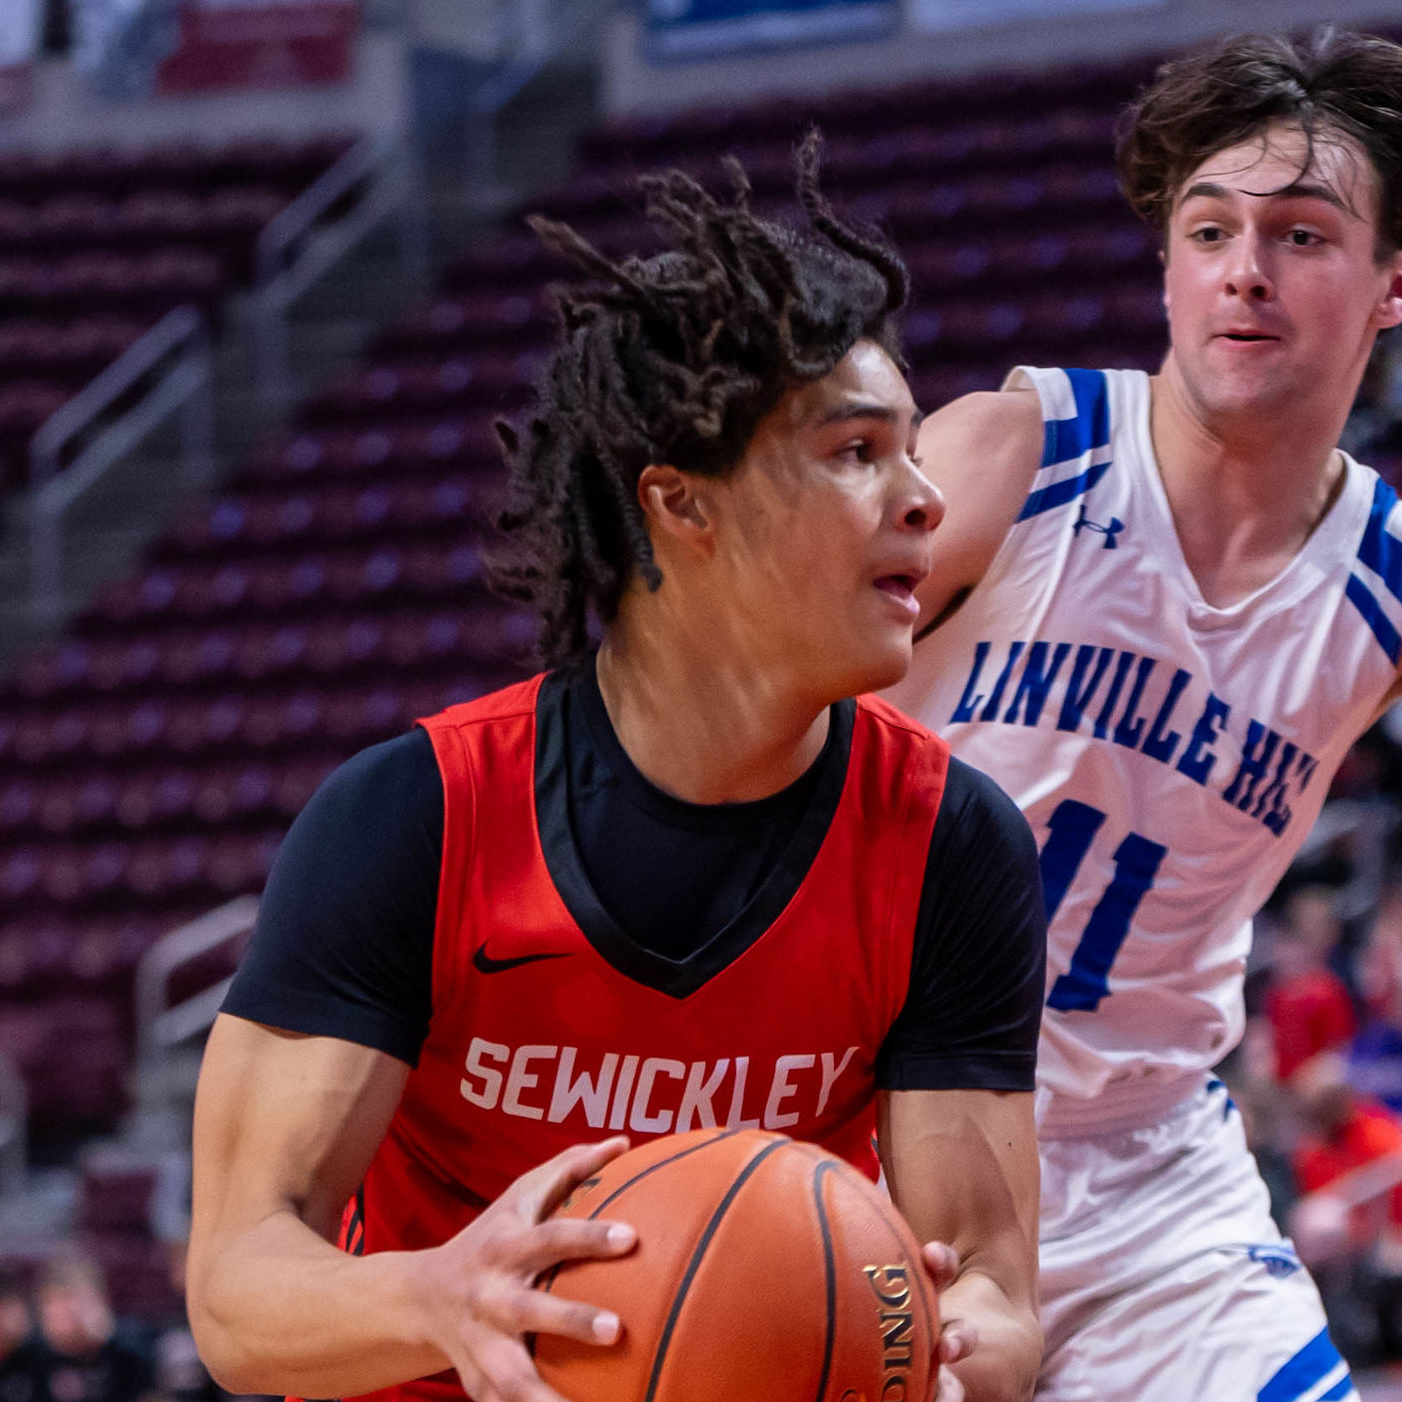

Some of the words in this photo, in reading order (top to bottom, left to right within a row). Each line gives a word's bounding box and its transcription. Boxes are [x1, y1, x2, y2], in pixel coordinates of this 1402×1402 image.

[949, 641, 1228, 786] LINVILLE
[1040, 799, 1168, 1012] 11
[459, 1036, 860, 1134] SEWICKLEY
